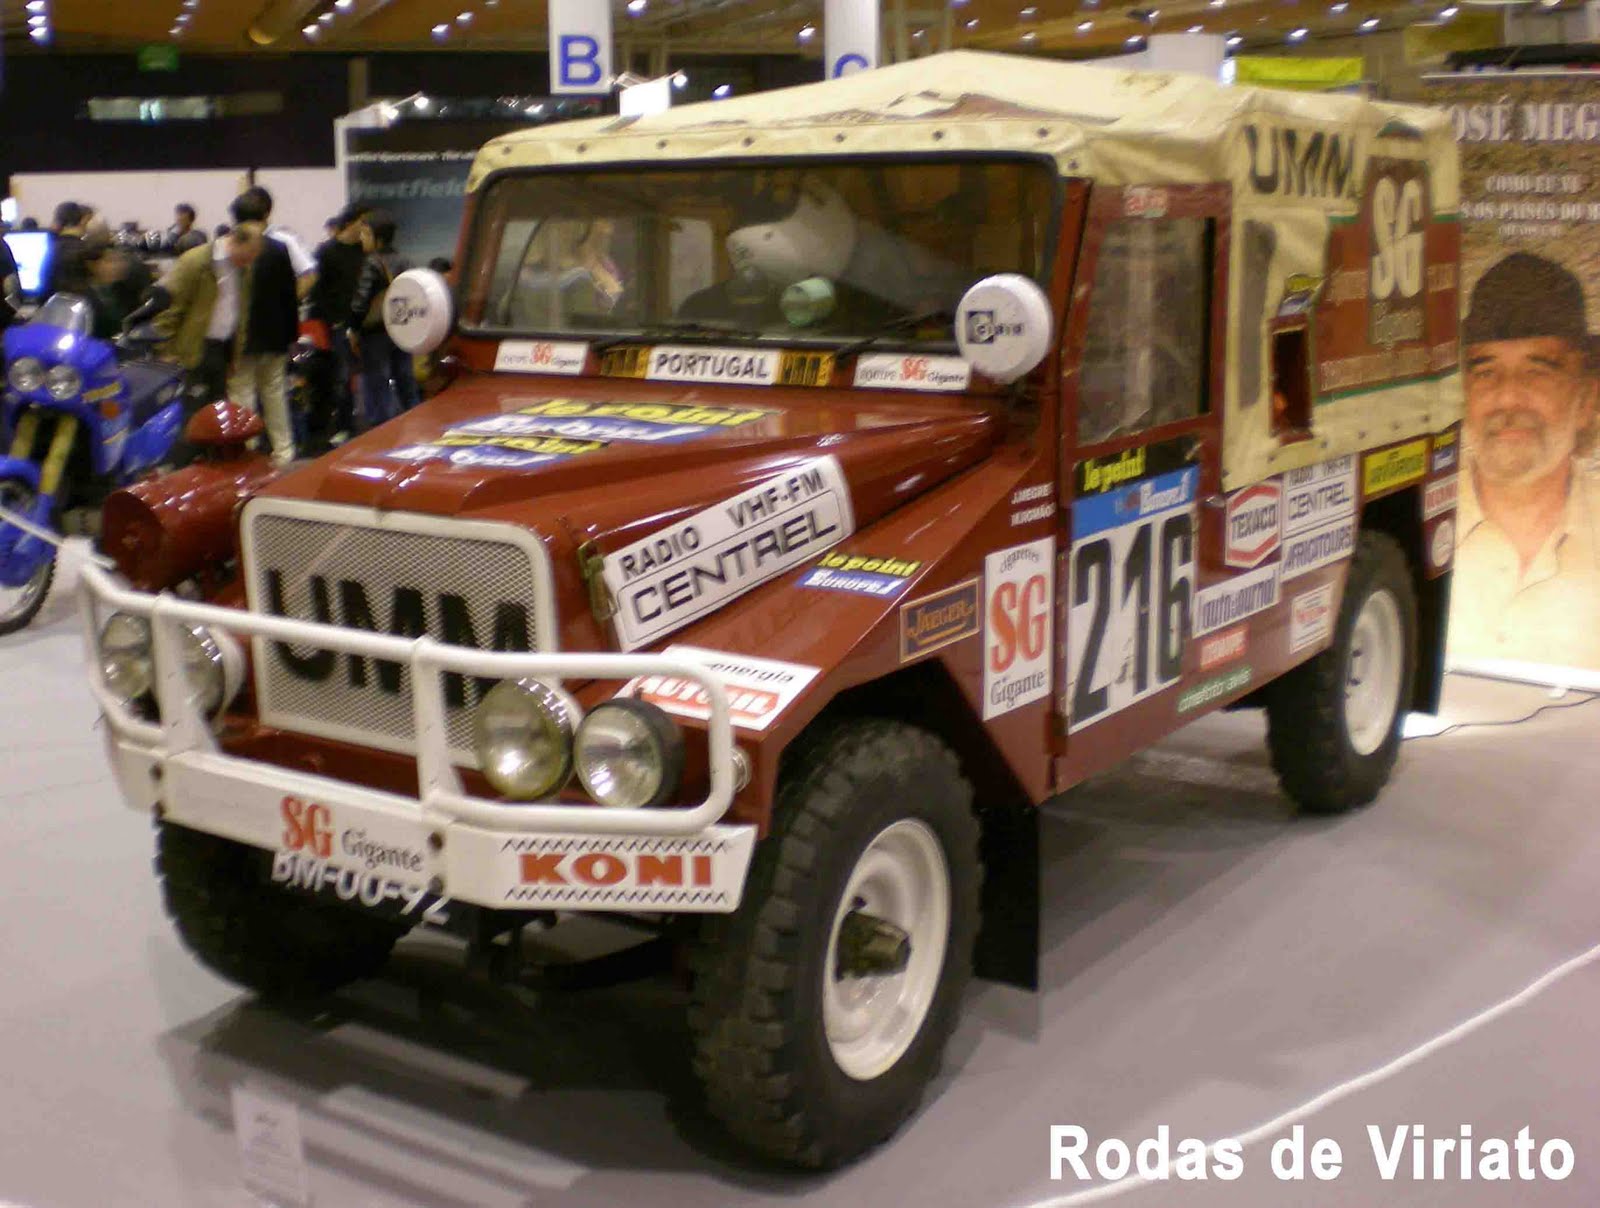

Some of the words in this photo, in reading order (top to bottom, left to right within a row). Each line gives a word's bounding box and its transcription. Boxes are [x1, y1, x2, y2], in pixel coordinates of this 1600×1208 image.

[559, 34, 601, 87] B
[654, 352, 769, 380] PORTUGAL
[1231, 502, 1277, 541] TEXACO
[619, 525, 701, 582] RADIO
[632, 510, 838, 623] CENTREL
[990, 574, 1047, 673] SG
[1070, 513, 1193, 729] 216
[990, 669, 1047, 709] Gigante
[281, 794, 334, 860] SG
[341, 828, 424, 872] Gigante
[518, 852, 713, 888] KONI
